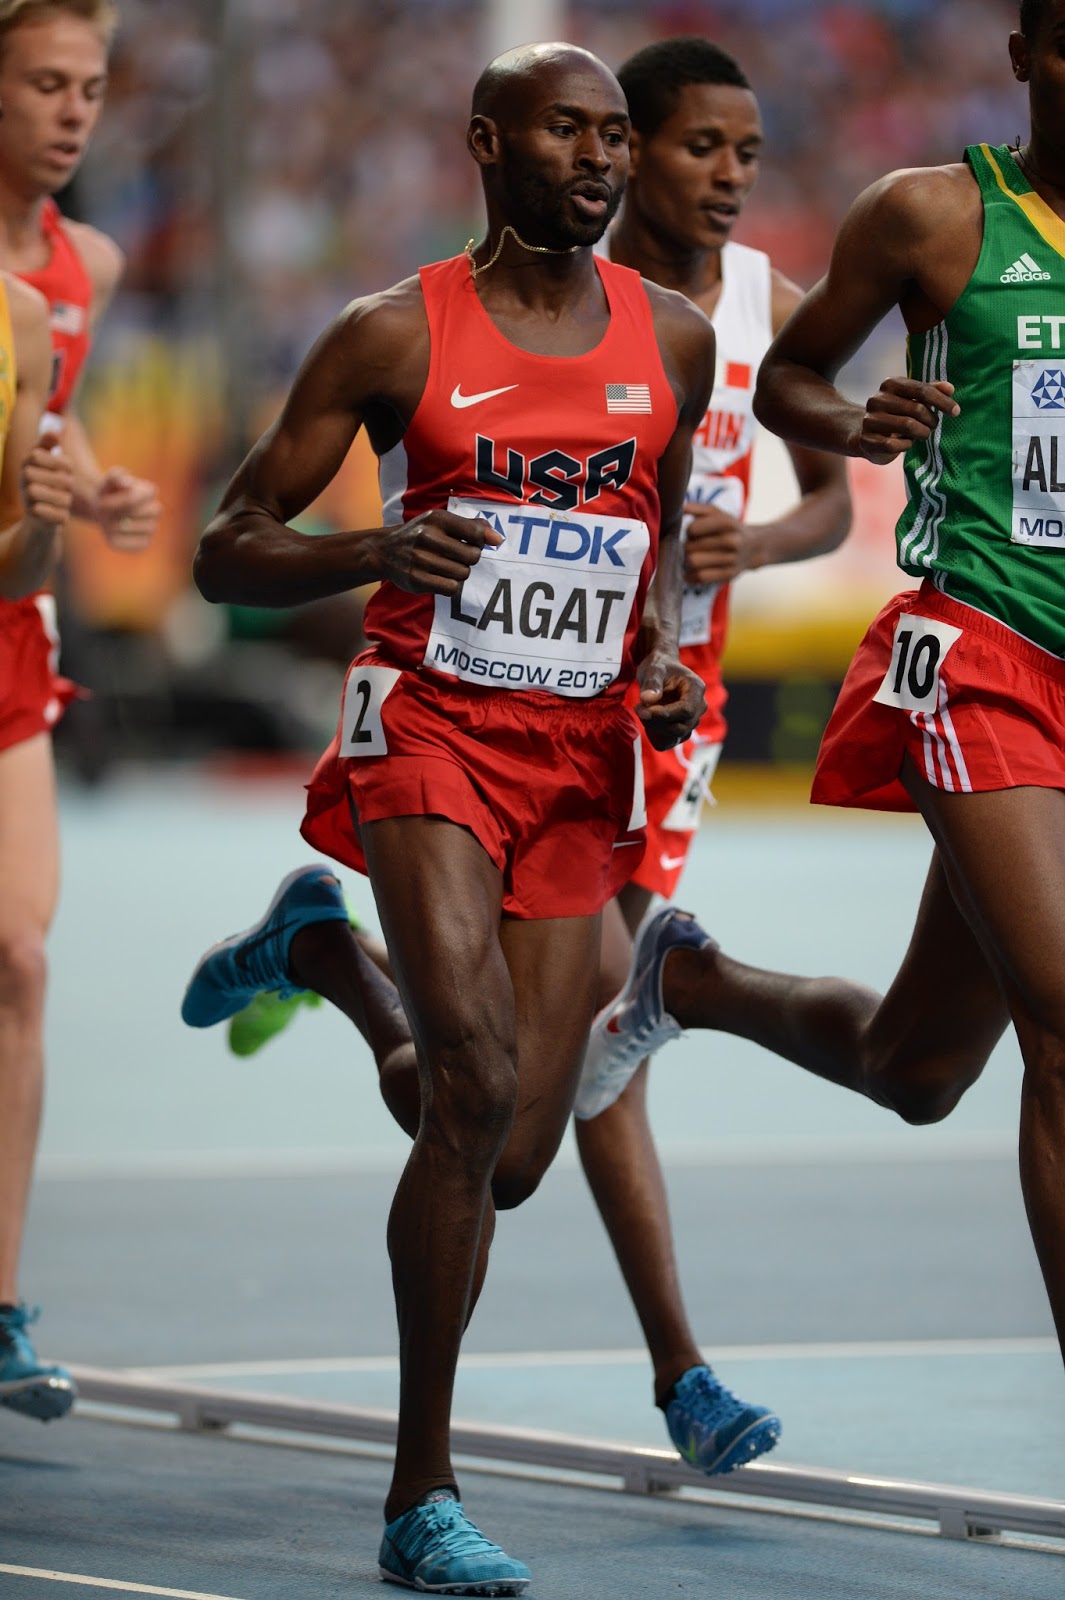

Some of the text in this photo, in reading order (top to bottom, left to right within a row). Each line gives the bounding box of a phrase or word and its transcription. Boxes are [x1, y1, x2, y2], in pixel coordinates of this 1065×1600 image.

[1000, 270, 1051, 283] adidas
[1017, 316, 1065, 348] ET
[476, 434, 637, 512] USA
[508, 514, 632, 567] TDK
[1019, 517, 1065, 538] MO
[450, 578, 625, 644] LAGAT
[433, 643, 613, 689] MOSCOW 2013
[893, 631, 941, 699] 10
[351, 680, 372, 743] 2
